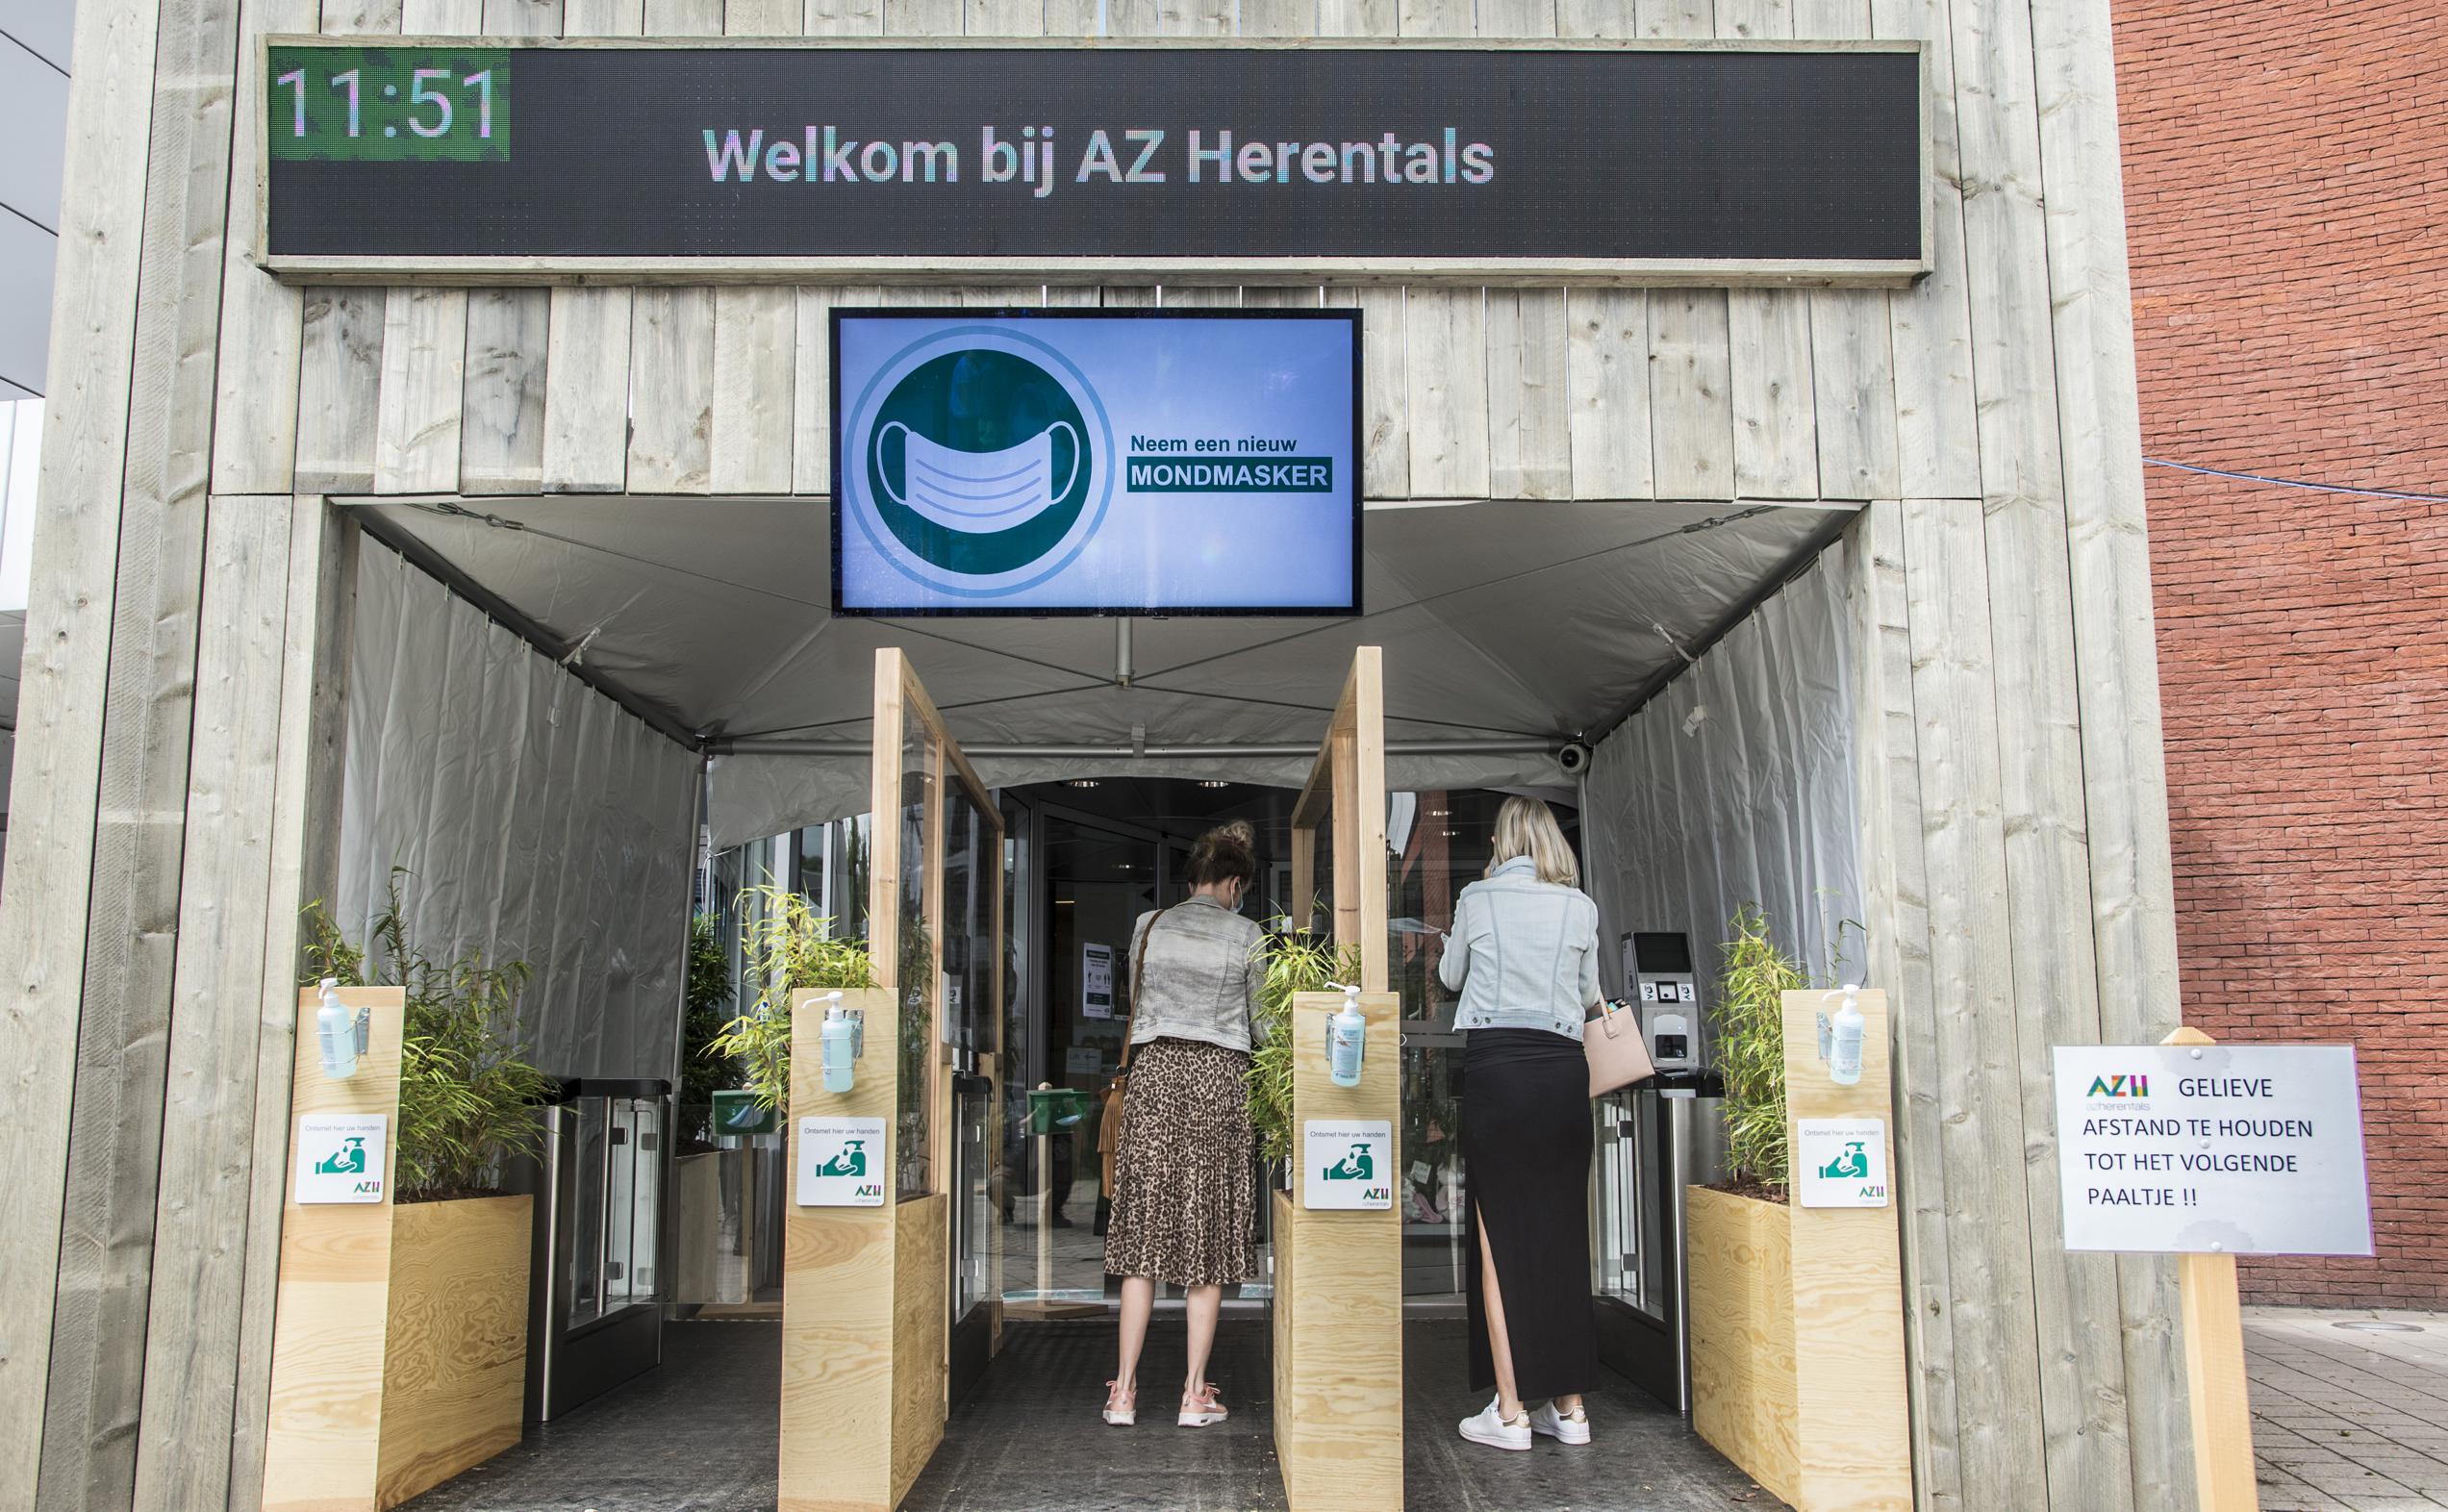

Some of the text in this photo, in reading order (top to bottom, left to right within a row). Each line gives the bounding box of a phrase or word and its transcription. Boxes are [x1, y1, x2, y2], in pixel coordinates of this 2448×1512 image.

[277, 68, 492, 138] 11:51
[702, 125, 1495, 198] Welkom bij AZ Herentals
[1130, 435, 1298, 452] Neem een nieuw
[1130, 464, 1328, 487] MONDMASKER
[2178, 1077, 2274, 1098] GELIEVE
[2082, 1119, 2313, 1138] AFSTAND TE HOUDEN
[2083, 1152, 2298, 1172] TOT HET VOLGENDE
[2087, 1187, 2198, 1206] PAALTJE !!
